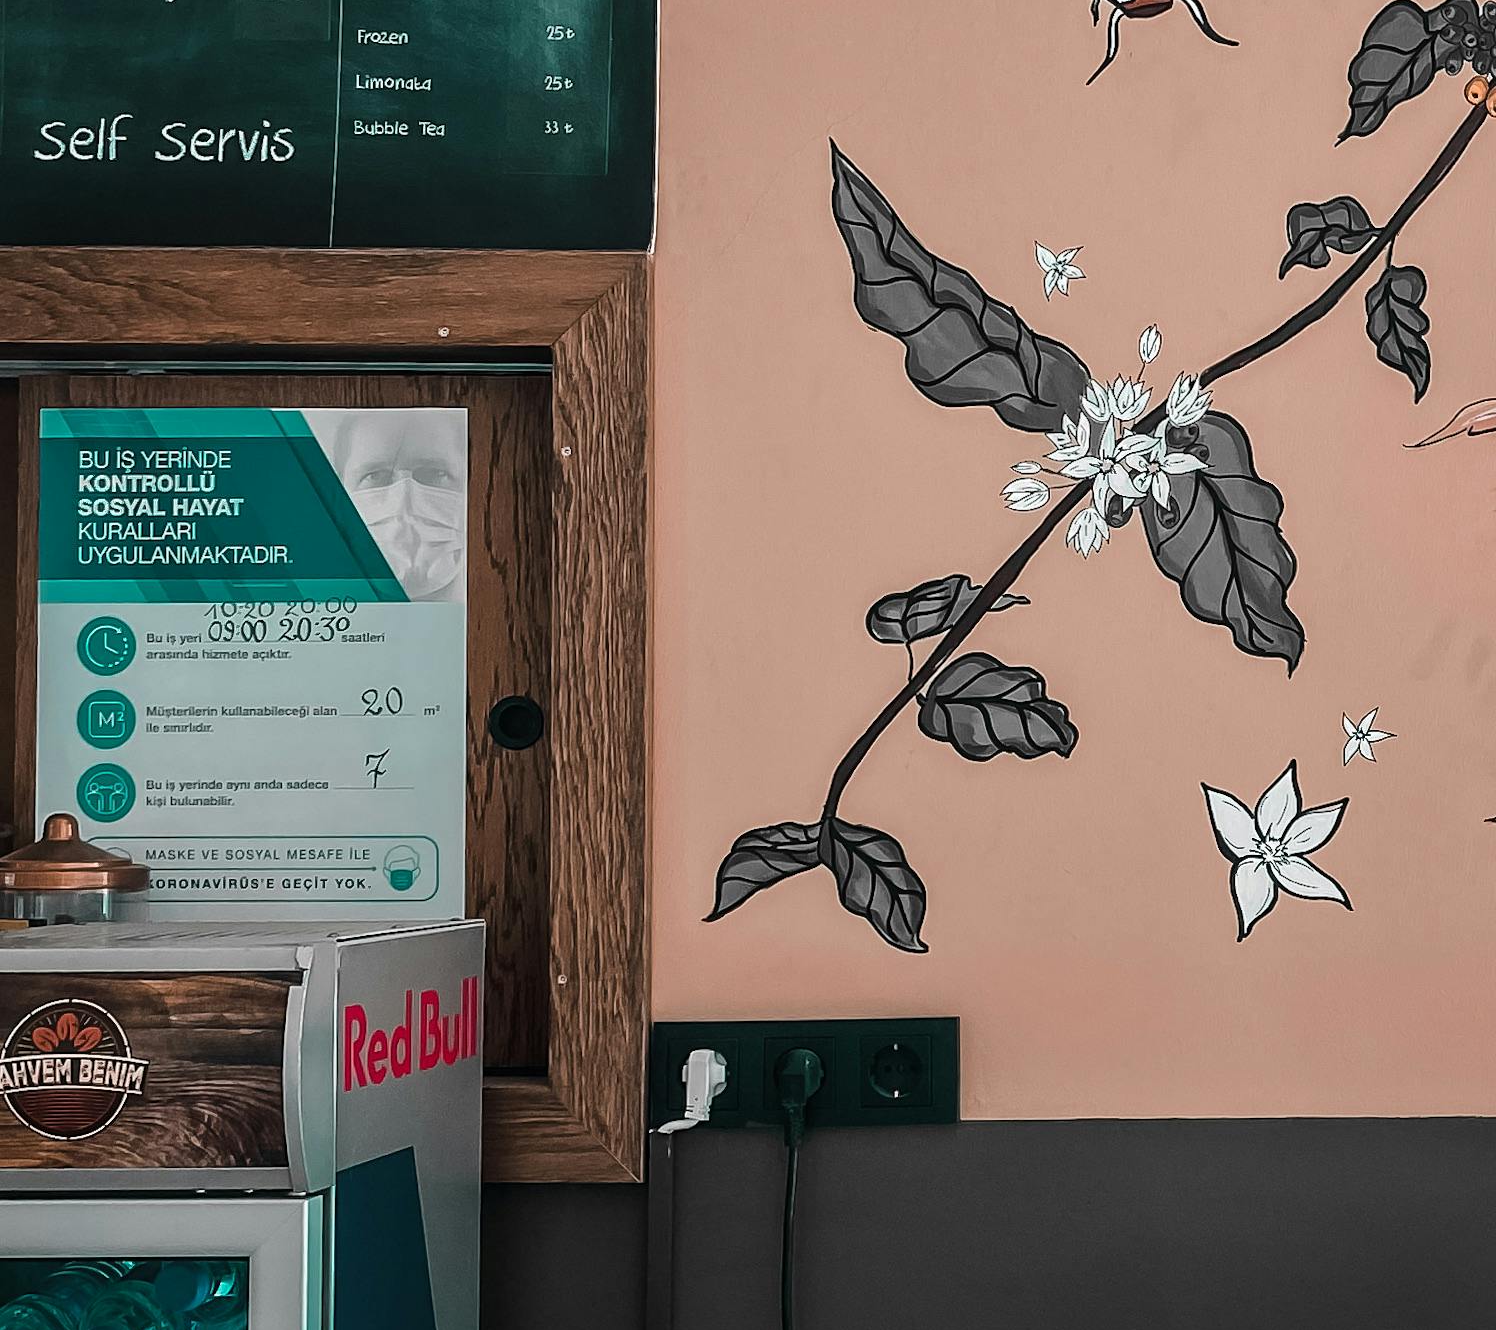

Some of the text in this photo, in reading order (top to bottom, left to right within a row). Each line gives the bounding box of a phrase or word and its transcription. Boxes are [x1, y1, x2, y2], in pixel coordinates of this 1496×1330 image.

[358, 30, 408, 44] Frozen
[356, 75, 431, 90] Limonata
[34, 114, 294, 162] Self Servis
[354, 121, 408, 135] Bubble
[419, 122, 444, 136] Tea
[79, 447, 232, 473] BU İŞ YERİNDE
[79, 472, 216, 493] KONTROLLÜ
[78, 498, 244, 517] SOSYAL HAYAT
[79, 522, 196, 540] KURALLARI
[78, 546, 293, 565] UYGULANMAKTADIR.
[146, 617, 385, 646] Bu iş yeri 09:00 20:30 saatleri
[146, 649, 292, 661] arasında hizmete açıktır.
[146, 706, 217, 717] Müşterilerin
[313, 706, 337, 716] alan
[361, 687, 403, 716] 20
[146, 723, 159, 733] ile
[146, 749, 390, 793] Bu iş yerinde aynı anda sadece 7
[146, 796, 167, 809] kişi
[145, 847, 371, 861] MASKE VE SOSYAL MESAFE İLE
[281, 875, 328, 892] GEÇİT
[335, 878, 372, 889] YOK.
[344, 976, 479, 1093] Red Bull
[0, 1059, 72, 1090] AHVEM
